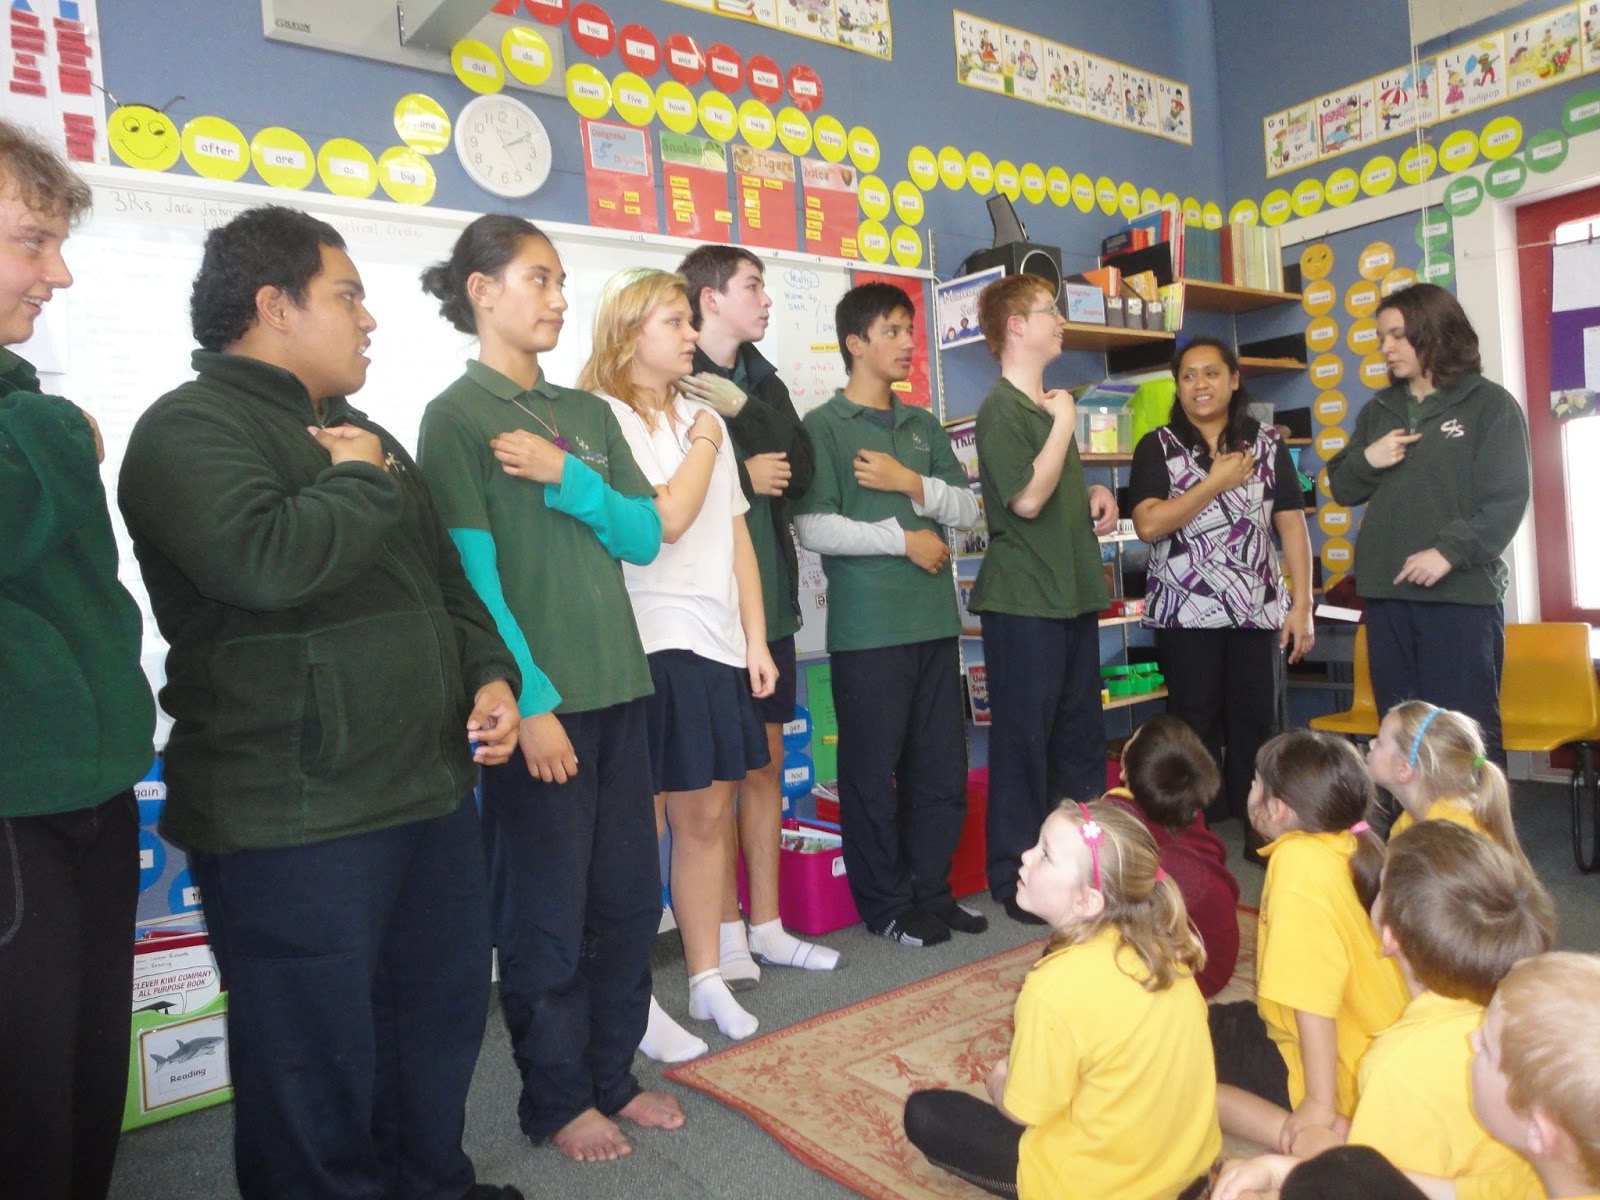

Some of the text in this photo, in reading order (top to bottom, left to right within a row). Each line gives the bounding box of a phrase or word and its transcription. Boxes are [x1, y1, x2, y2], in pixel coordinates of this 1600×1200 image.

[784, 16, 797, 27] pig
[522, 51, 534, 62] do
[636, 47, 646, 57] up
[472, 62, 487, 73] did
[678, 57, 691, 66] was
[717, 64, 734, 75] went
[757, 75, 775, 85] when
[1516, 77, 1532, 90] fish
[578, 86, 600, 97] down
[800, 84, 812, 94] you
[627, 95, 642, 105] five
[1468, 88, 1500, 105] lollipop
[668, 102, 686, 113] have
[485, 112, 493, 125] 11
[498, 111, 507, 123] 12
[714, 111, 723, 120] he
[474, 121, 485, 134] 10
[751, 119, 765, 131] help
[784, 126, 806, 138] helped
[820, 133, 842, 146] helping
[1493, 134, 1510, 143] with
[201, 143, 235, 157] after
[275, 153, 294, 166] are
[758, 154, 793, 174] Tigers
[343, 166, 355, 176] as
[400, 170, 416, 183] big
[111, 190, 152, 213] 3Rs
[165, 194, 193, 214] Jack
[943, 281, 989, 304] Managin
[135, 787, 159, 799] gain
[133, 970, 212, 990] CLEVER KIWI COMPANY
[138, 978, 206, 998] ALL PURPOSE BOOK
[170, 1066, 207, 1084] Reading
